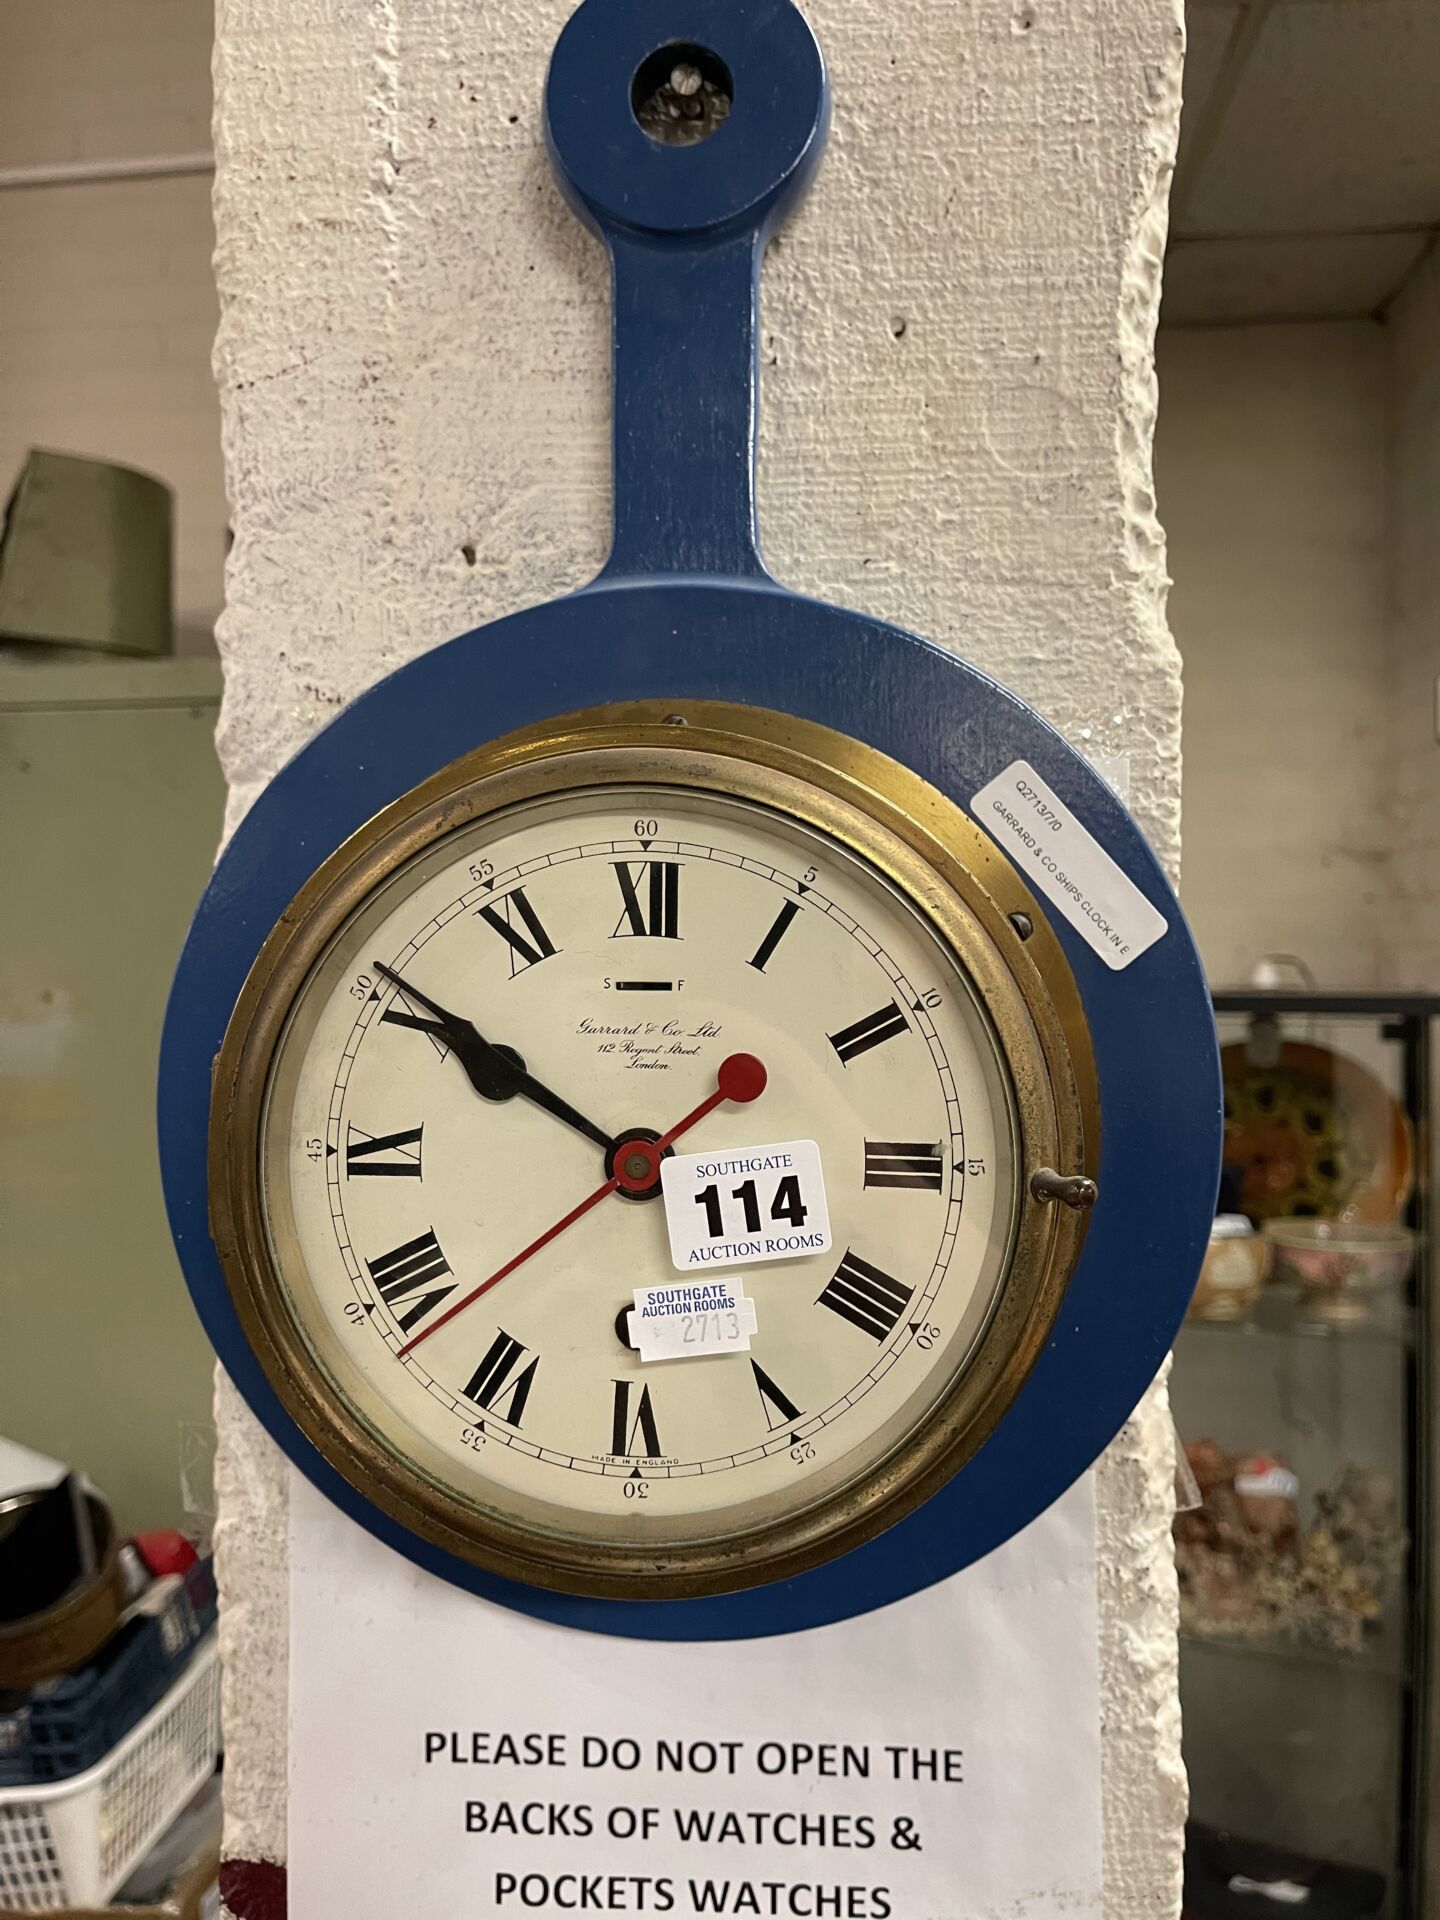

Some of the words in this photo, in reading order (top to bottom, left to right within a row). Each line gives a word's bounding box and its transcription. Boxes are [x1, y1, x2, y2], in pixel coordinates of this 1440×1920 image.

[1016, 780, 1063, 832] Q2713/7/0
[634, 819, 658, 837] 60
[469, 859, 494, 882] 55
[803, 866, 818, 883] 5
[992, 800, 1036, 849] GARRARD
[1033, 848, 1043, 857] &
[1041, 857, 1056, 873] CO
[1055, 872, 1083, 903] SHIPS
[1080, 901, 1111, 936] CLOCK
[1110, 931, 1123, 947] IN
[1119, 945, 1130, 956] E
[607, 861, 685, 940] XII
[472, 885, 564, 980] XI
[350, 974, 373, 1001] 50
[604, 978, 611, 989] S
[678, 980, 685, 991] F
[921, 987, 943, 1009] 10
[576, 1017, 643, 1035] Garrard
[645, 1022, 659, 1035] &
[825, 997, 912, 1068] II
[619, 1039, 663, 1059] Regent
[307, 1138, 323, 1163] 45
[347, 1120, 424, 1183] IX
[696, 1154, 793, 1178] SOUTHGATE
[863, 1137, 943, 1195] III
[968, 1157, 985, 1178] 15
[694, 1175, 808, 1238] 114
[688, 1241, 761, 1262] AUCTION
[766, 1233, 824, 1253] ROOMS
[365, 1225, 460, 1337] VIII
[648, 1284, 727, 1305] SOUTHGATE
[343, 1302, 364, 1327] 40
[642, 1302, 692, 1318] AUCTION
[694, 1297, 735, 1312] ROOMS
[682, 1312, 740, 1343] 2713
[916, 1323, 940, 1350] 20
[458, 1326, 540, 1430] VII
[750, 1357, 807, 1433] V
[606, 1379, 667, 1458] VI
[460, 1428, 486, 1452] 35
[790, 1441, 816, 1465] 25
[592, 1455, 616, 1463] MADE
[636, 1458, 679, 1466] ENGLAND
[623, 1481, 649, 1499] 30
[425, 1732, 567, 1766] PLEASE
[582, 1737, 641, 1771] DO
[657, 1740, 743, 1775] NOT
[757, 1742, 870, 1778] OPEN
[885, 1746, 964, 1783] THE
[464, 1800, 593, 1836] BACKS
[607, 1806, 660, 1840] OF
[674, 1809, 876, 1848] WATCHES
[890, 1816, 922, 1851] &
[495, 1872, 674, 1911] POCKETS
[689, 1879, 891, 1919] WATCHES
